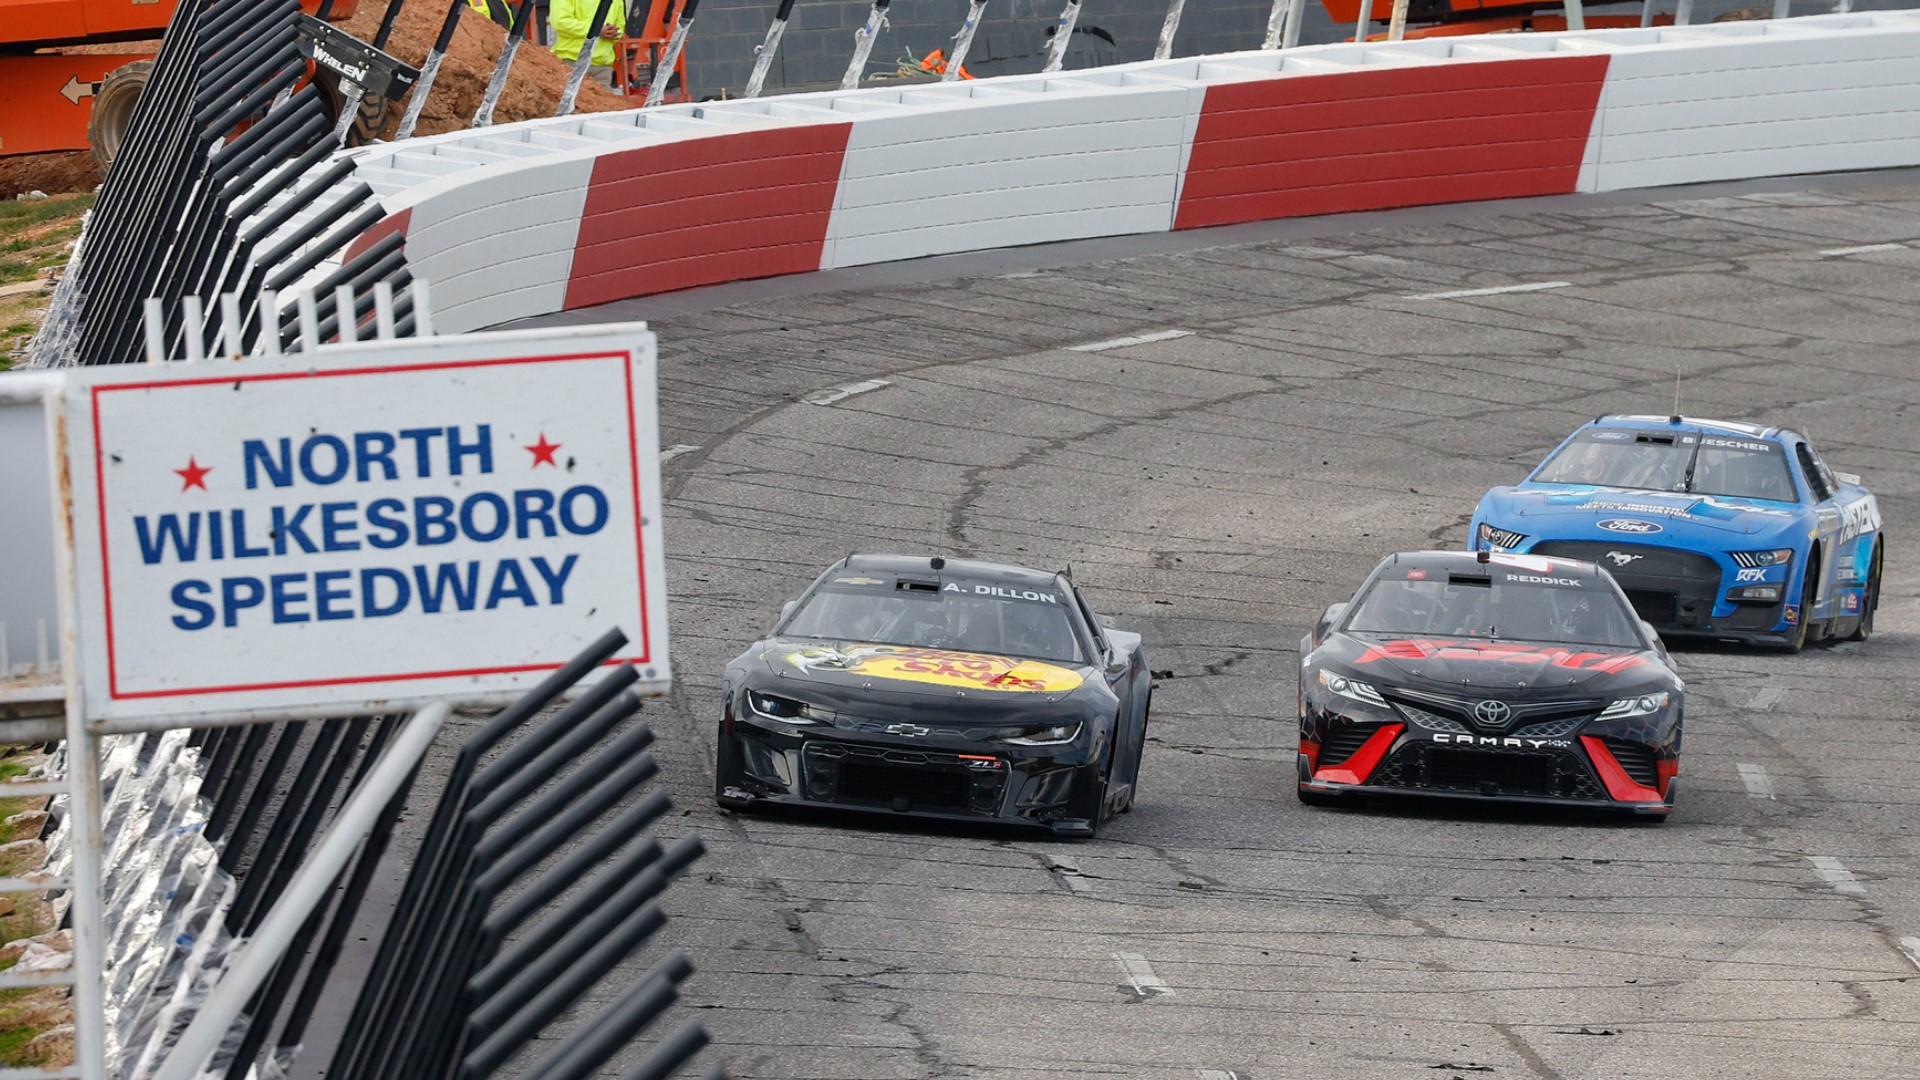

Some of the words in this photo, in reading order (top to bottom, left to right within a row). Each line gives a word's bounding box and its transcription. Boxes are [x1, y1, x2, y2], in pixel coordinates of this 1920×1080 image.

[313, 44, 367, 81] WHELEN
[243, 424, 495, 490] NORTH
[134, 485, 610, 565] WILKESBORO
[1506, 574, 1584, 587] REDDICK
[1735, 569, 1767, 581] RFK
[170, 554, 580, 631] SPEEDWAY
[943, 583, 968, 592] A.
[975, 585, 1057, 604] DILLON
[1433, 733, 1547, 748] CAMRY
